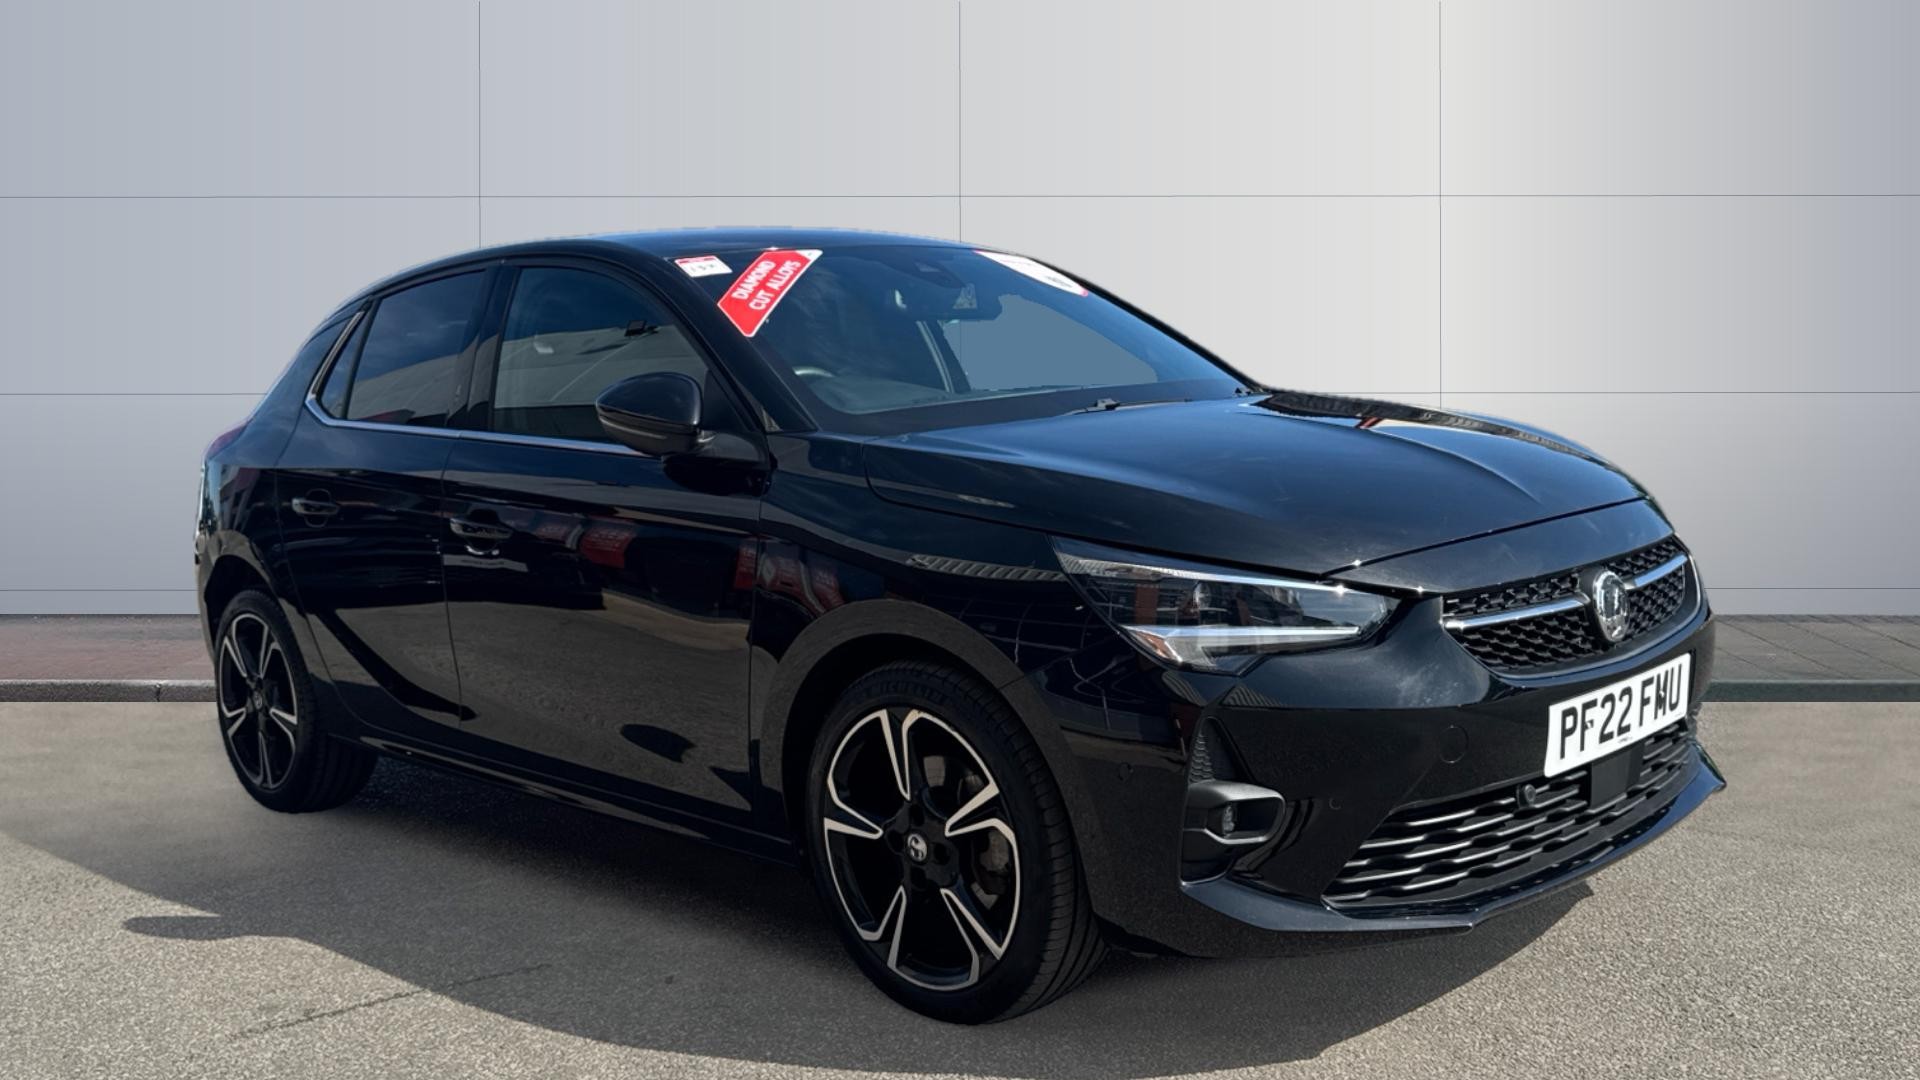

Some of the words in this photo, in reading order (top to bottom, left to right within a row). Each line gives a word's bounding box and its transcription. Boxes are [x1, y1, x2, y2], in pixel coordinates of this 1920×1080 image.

[732, 260, 776, 299] DIAMOND
[748, 289, 774, 310] CUT
[766, 260, 801, 290] ALLOYS
[1560, 686, 1633, 760] PF22
[1639, 663, 1682, 727] FMU
